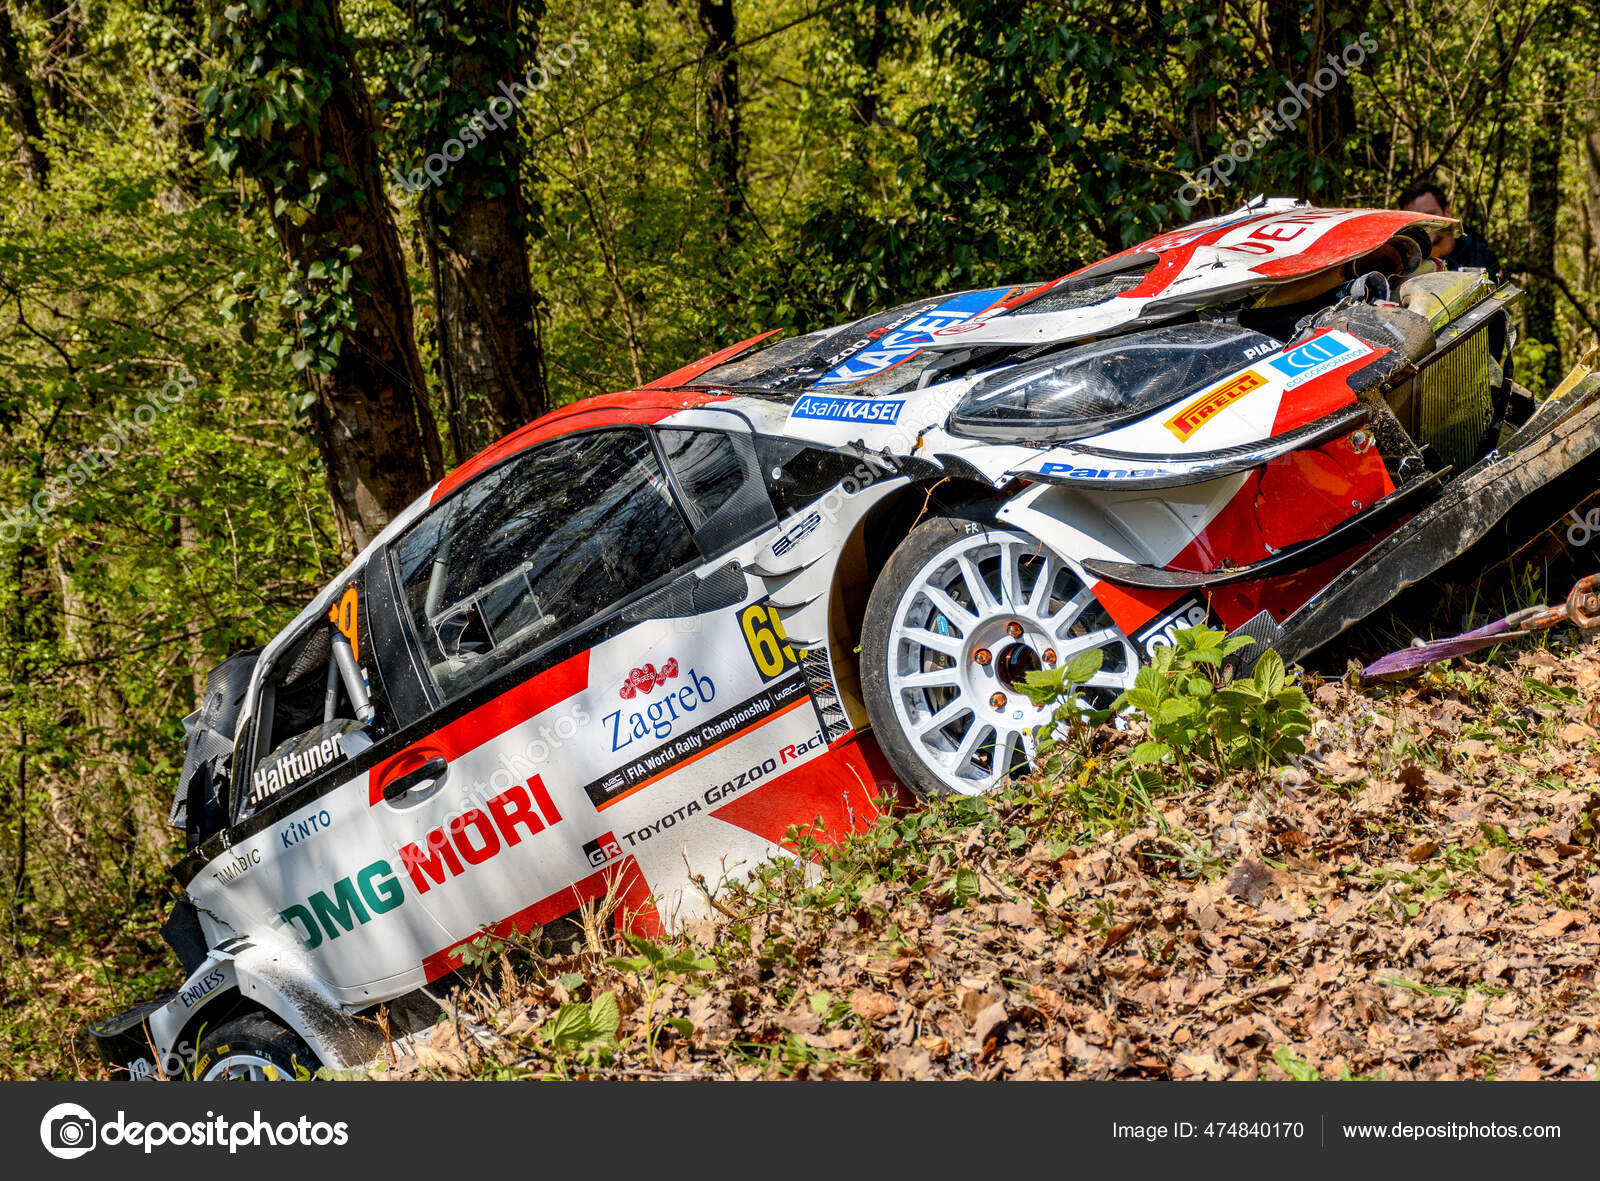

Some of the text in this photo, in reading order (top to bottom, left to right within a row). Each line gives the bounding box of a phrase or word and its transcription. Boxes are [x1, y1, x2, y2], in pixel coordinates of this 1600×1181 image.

[1243, 340, 1283, 361] PIAA
[1286, 346, 1368, 389] CCI CORPORATION
[1287, 342, 1334, 369] CCI
[1173, 374, 1260, 435] PIRELLI
[602, 668, 716, 753] Zagreb
[627, 763, 647, 780] FIA
[645, 747, 676, 771] World
[675, 734, 703, 755] Rally
[702, 698, 771, 741] Championship
[588, 730, 825, 867] GR TOYOTA GAZOO Raci
[280, 773, 564, 951] DMG MORI
[181, 967, 225, 1009] ENDLESS
